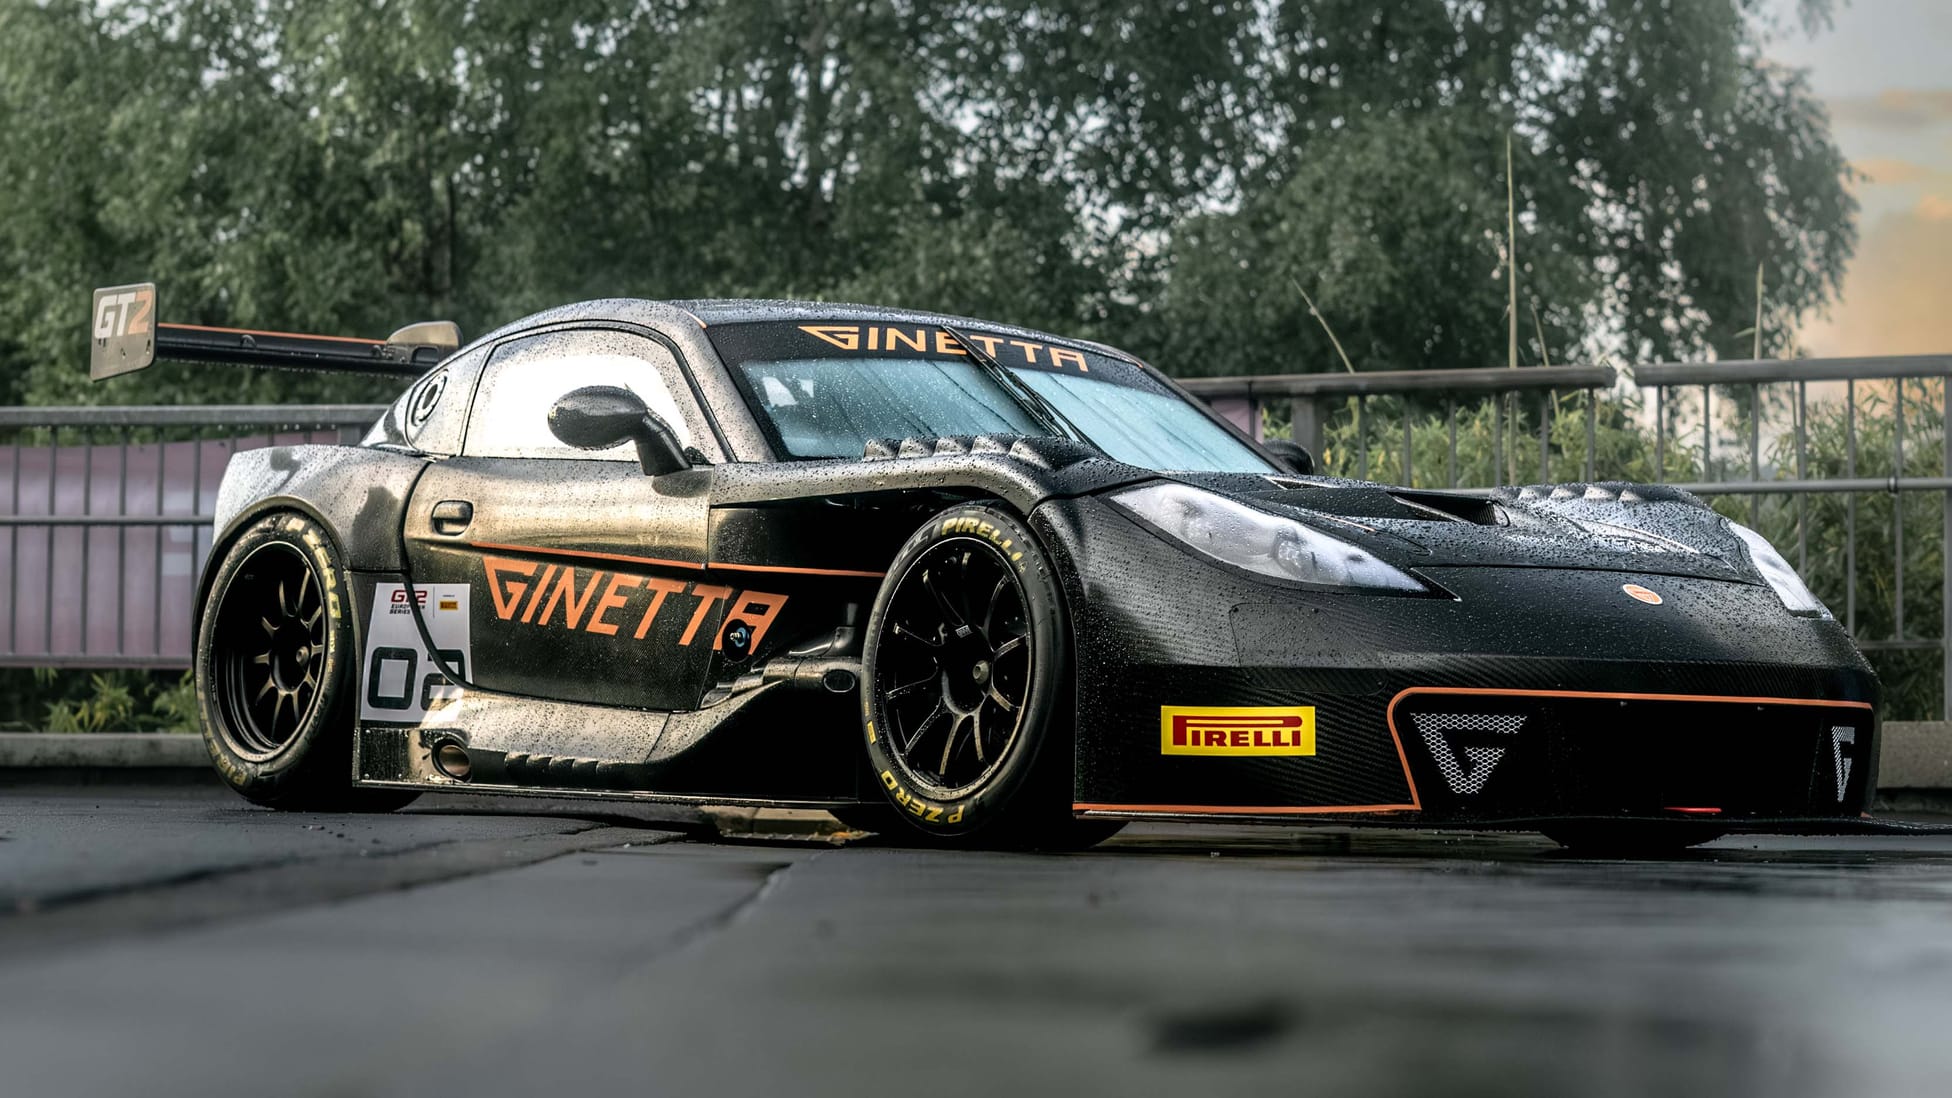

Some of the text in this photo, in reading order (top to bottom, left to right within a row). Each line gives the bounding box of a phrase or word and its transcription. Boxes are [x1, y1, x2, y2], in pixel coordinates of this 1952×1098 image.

[94, 290, 153, 339] GT2
[798, 325, 1089, 373] GINETTA
[941, 516, 1024, 562] PIRELLI
[391, 589, 428, 604] G2
[482, 555, 789, 655] GINETTA
[1172, 715, 1303, 747] PIRELLI
[881, 770, 944, 823] ZERO
